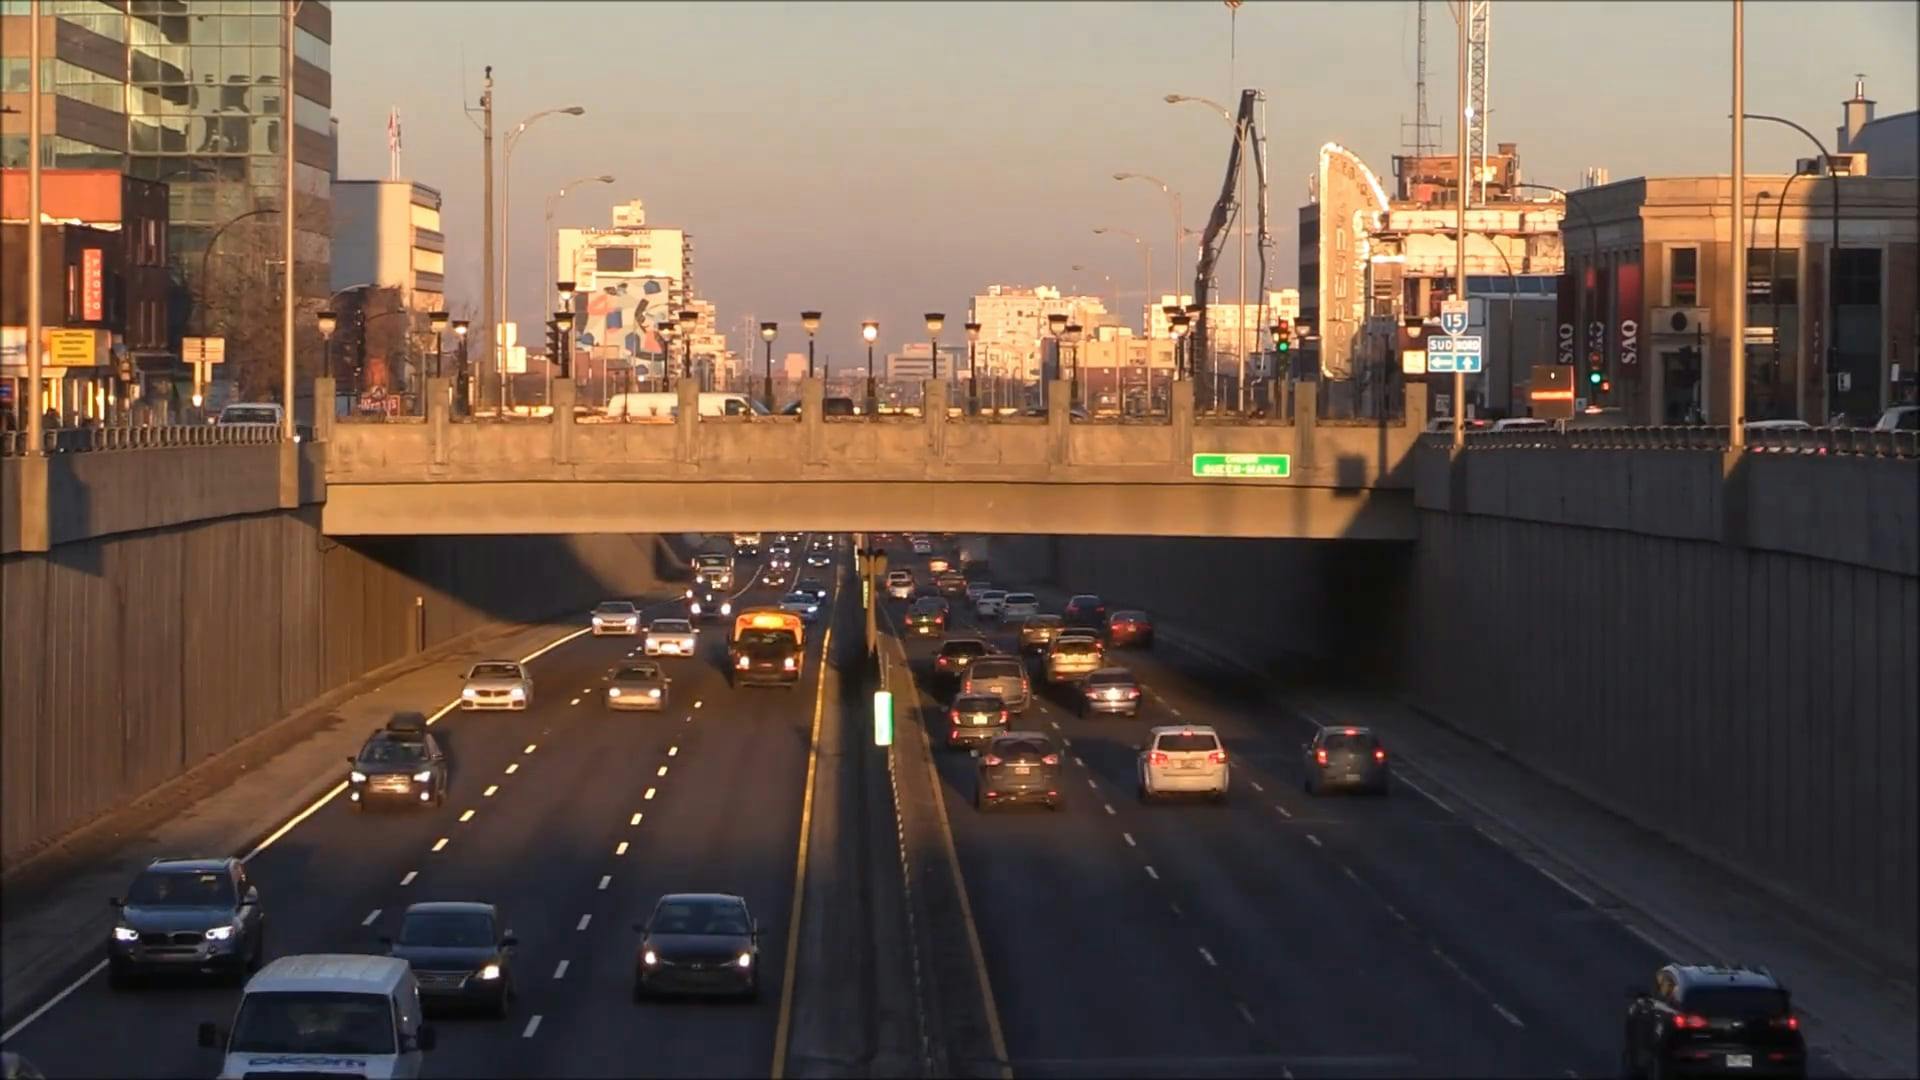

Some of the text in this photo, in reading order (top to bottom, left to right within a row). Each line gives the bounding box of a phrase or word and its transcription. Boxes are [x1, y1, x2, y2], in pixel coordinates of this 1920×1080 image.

[1446, 313, 1463, 328] 15
[1430, 339, 1453, 351] SUD
[1560, 323, 1574, 363] SAQ
[1620, 320, 1638, 364] SAQ
